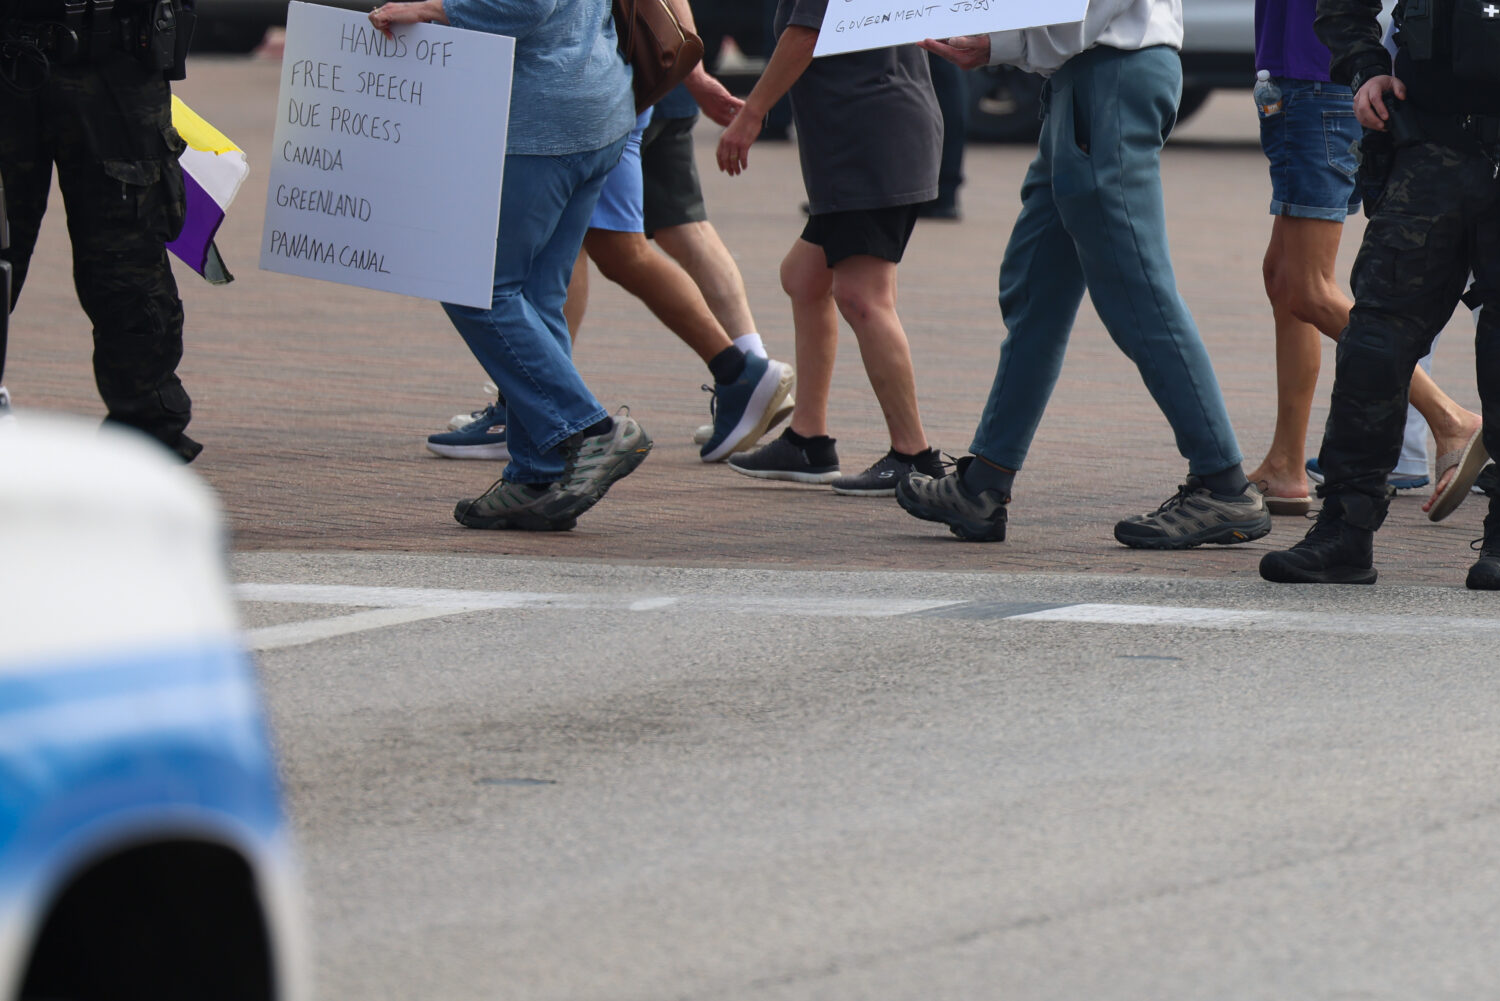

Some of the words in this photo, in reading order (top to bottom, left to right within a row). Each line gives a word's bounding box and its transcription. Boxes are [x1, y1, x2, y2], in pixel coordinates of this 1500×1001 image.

[340, 23, 408, 58] HANDS
[415, 39, 454, 67] OFF
[291, 60, 345, 93] FREE
[355, 71, 424, 106] SPEECH
[288, 98, 321, 128] DUE
[330, 105, 402, 144] PROCESS
[282, 140, 344, 171] CANADA
[276, 184, 372, 223] GREENLAND
[270, 229, 335, 264] PANAMA
[338, 245, 391, 274] CANAL
